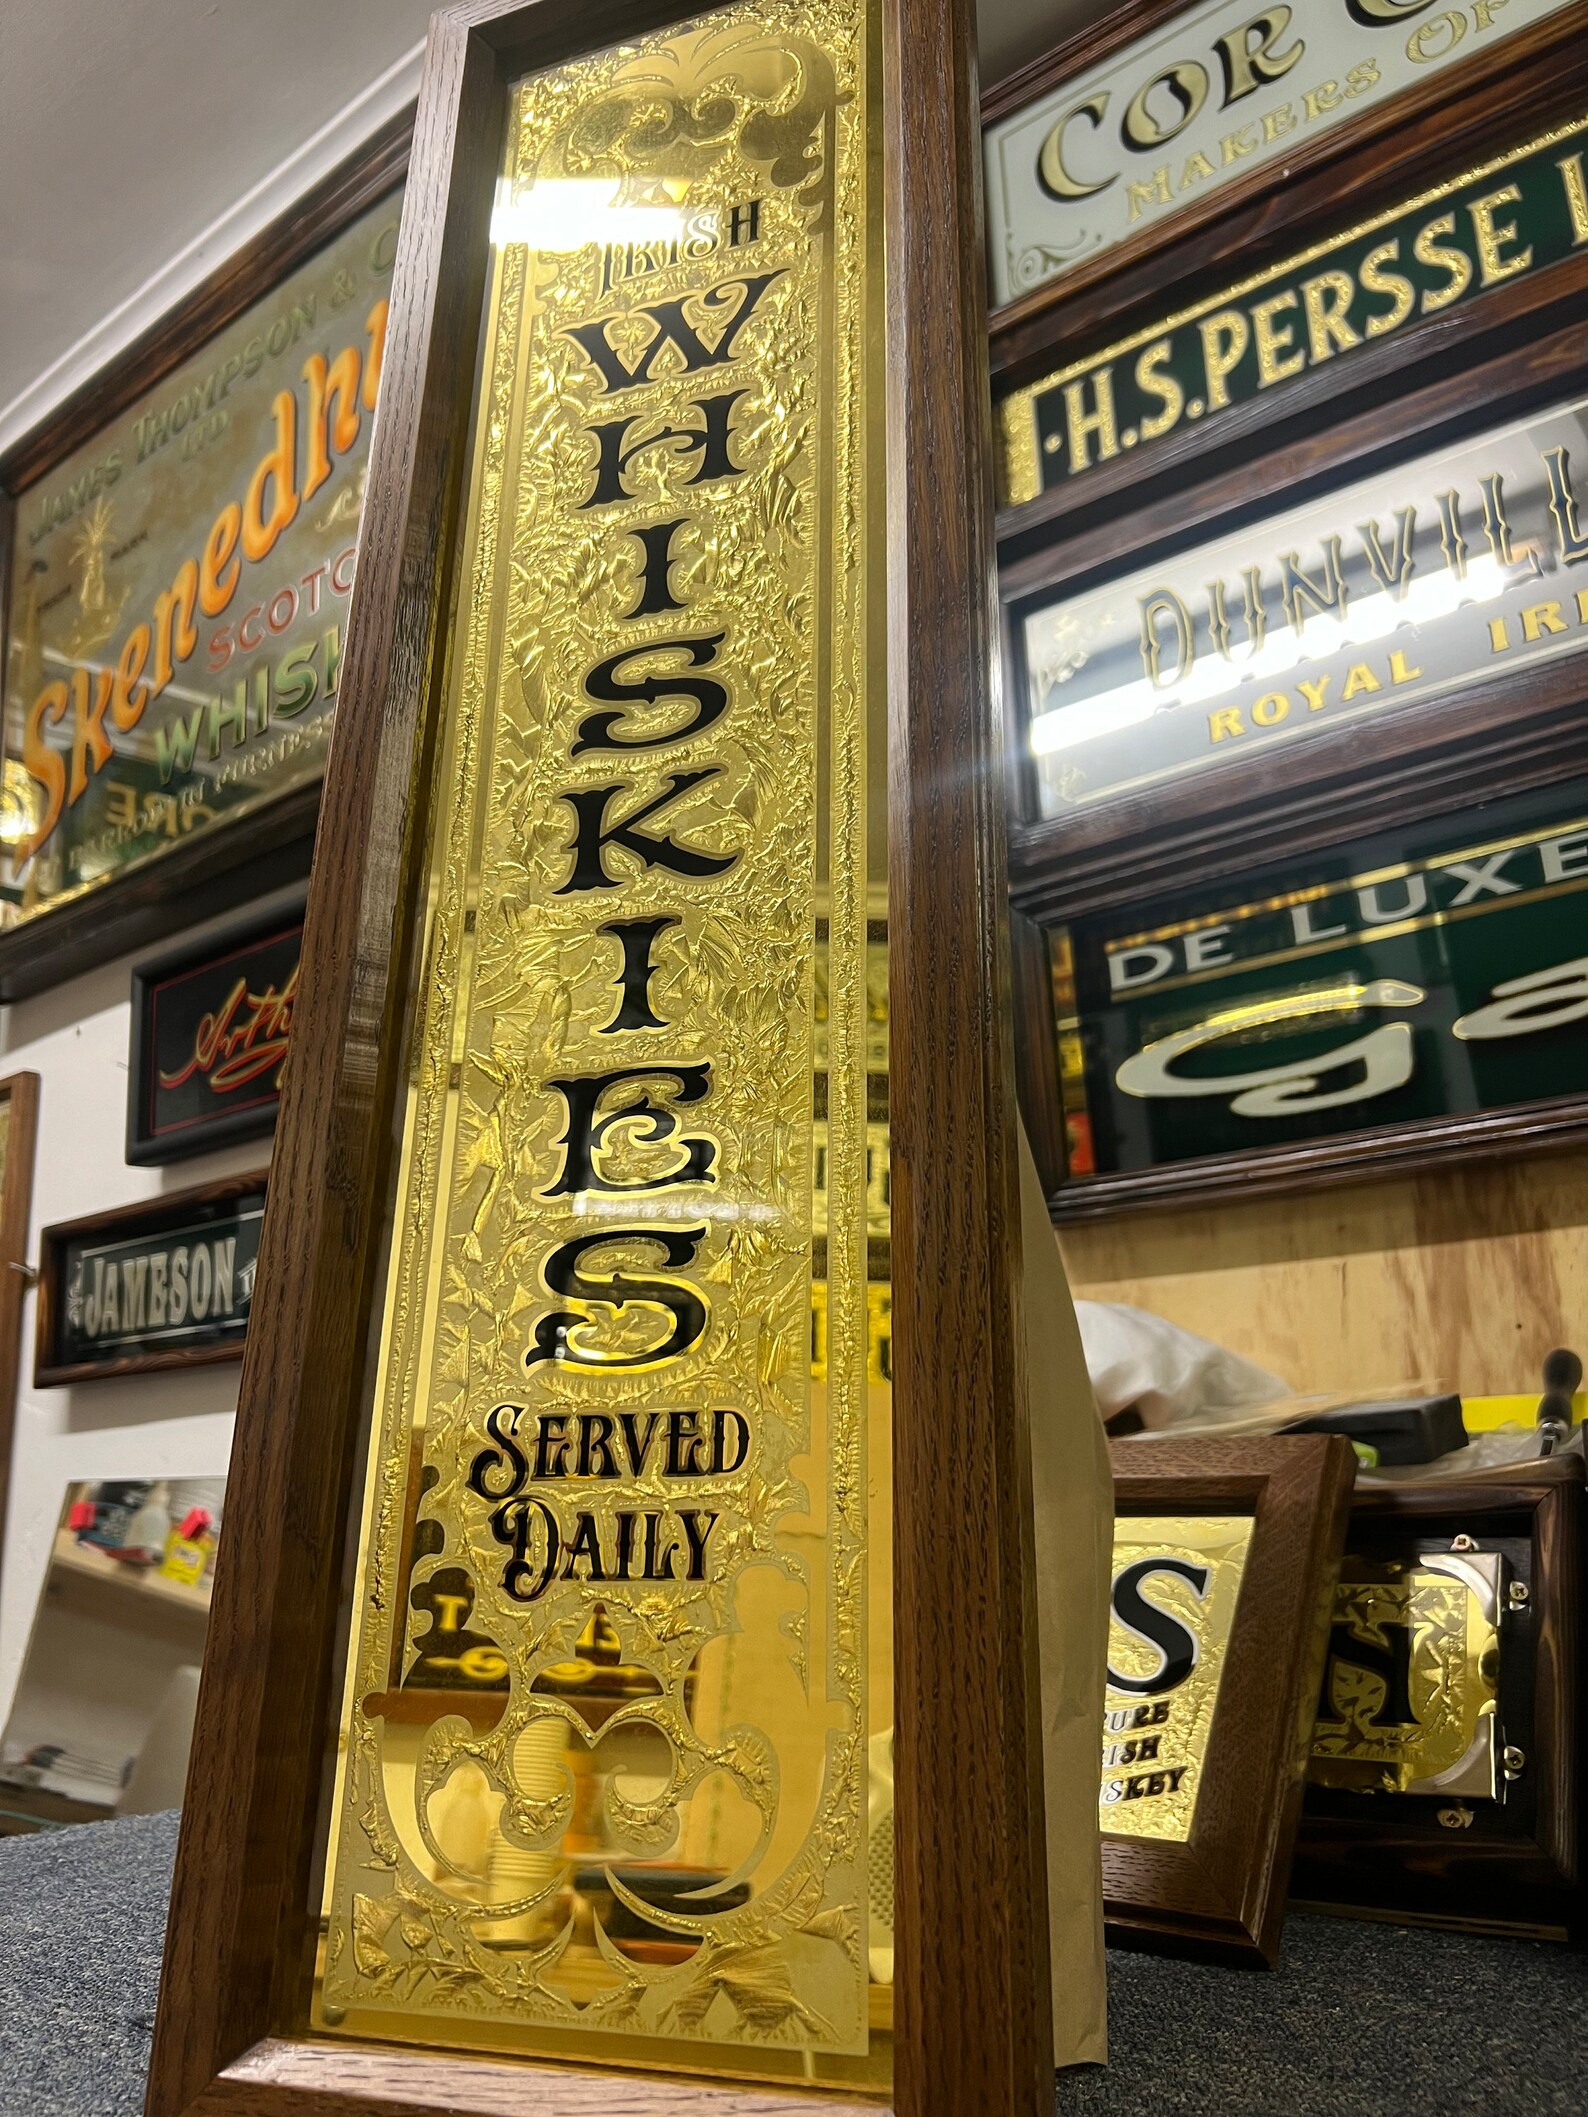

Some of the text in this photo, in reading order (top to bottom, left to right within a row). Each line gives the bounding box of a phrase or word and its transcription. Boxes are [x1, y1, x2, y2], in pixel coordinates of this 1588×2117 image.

[1125, 56, 1382, 225] MAKERS
[131, 293, 318, 465] THOMPSON
[207, 547, 358, 674] SCOTC
[1208, 650, 1424, 745] ROYAL
[1105, 924, 1235, 992] DE
[84, 1236, 237, 1339] JAMESON
[466, 1404, 751, 1500] SERVED
[490, 1497, 721, 1601] DAILY
[1102, 1734, 1162, 1768] ISH
[1103, 1699, 1171, 1733] URE
[1100, 1764, 1189, 1806] SKEY
